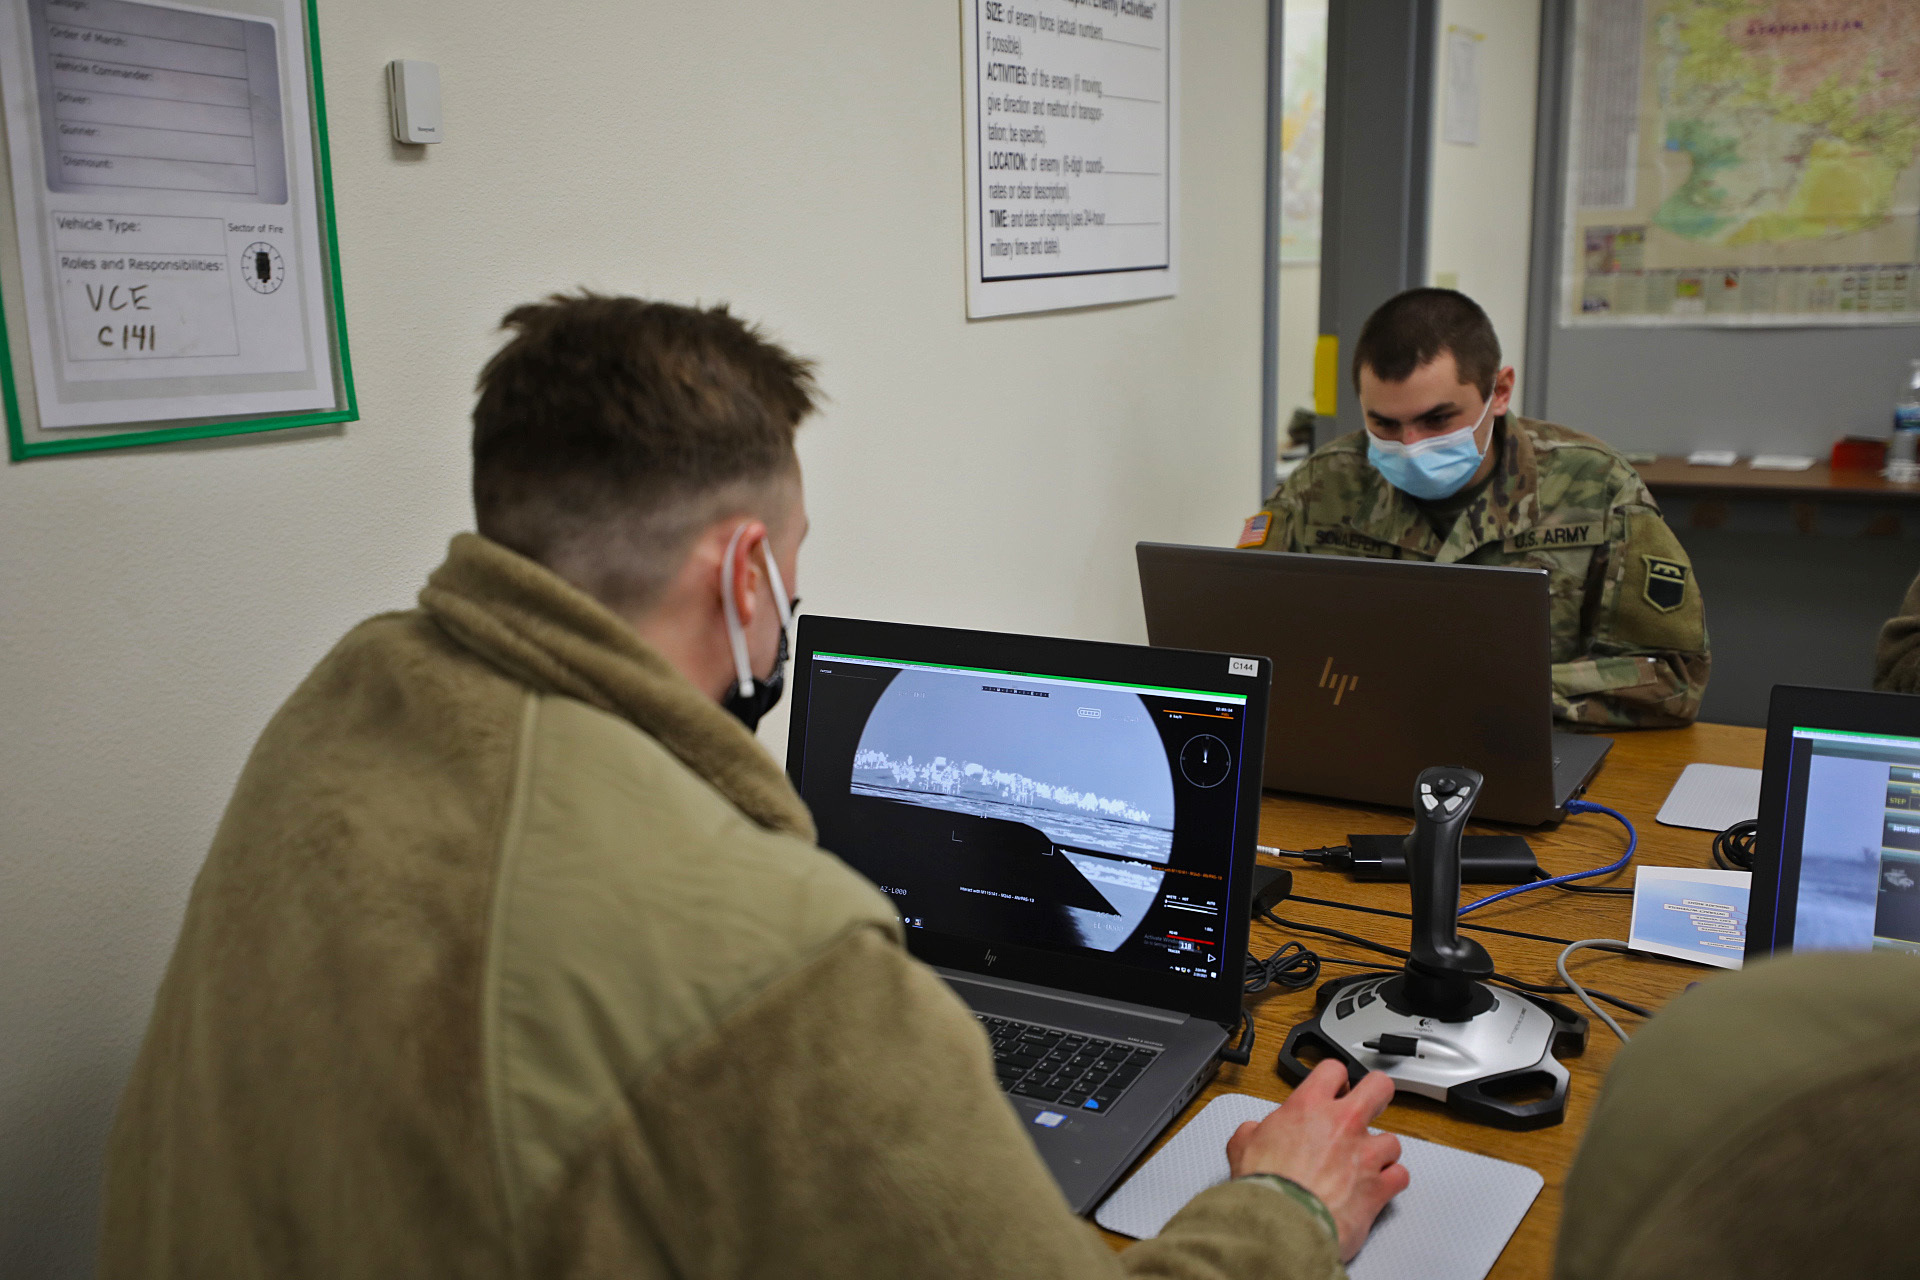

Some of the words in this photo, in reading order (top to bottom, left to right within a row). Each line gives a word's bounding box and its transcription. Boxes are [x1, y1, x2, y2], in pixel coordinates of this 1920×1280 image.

[986, 1, 1005, 22] SIZE:
[1007, 5, 1015, 23] of
[1016, 10, 1037, 33] enemy
[1039, 11, 1055, 32] force
[987, 61, 1029, 85] ACTIVITIES:
[1031, 68, 1039, 86] of
[1040, 68, 1050, 88] the
[1052, 75, 1072, 96] enemy
[987, 92, 1001, 116] give
[1032, 97, 1045, 116] and
[1071, 101, 1078, 119] of
[1009, 123, 1018, 142] be
[989, 151, 1028, 170] LOCATION:
[1031, 152, 1038, 171] of
[1039, 157, 1060, 176] enemy
[1017, 181, 1033, 199] clear
[57, 217, 102, 231] Vehicle
[106, 218, 141, 234] Type:
[1011, 209, 1024, 227] and
[1025, 209, 1038, 227] date
[228, 222, 254, 233] Sector
[258, 224, 266, 233] of
[268, 224, 284, 234] Fire
[1030, 237, 1042, 255] and
[61, 257, 96, 270] Roles
[101, 257, 124, 270] and
[129, 258, 224, 273] Responsibilities:
[86, 284, 151, 312] VCE
[1514, 530, 1539, 548] U.S.
[1543, 525, 1589, 544] ARMY
[1233, 661, 1253, 671] C144
[1889, 797, 1907, 805] STEP
[1893, 825, 1906, 833] Jam
[1907, 826, 1920, 834] Gun
[1181, 942, 1192, 950] 118
